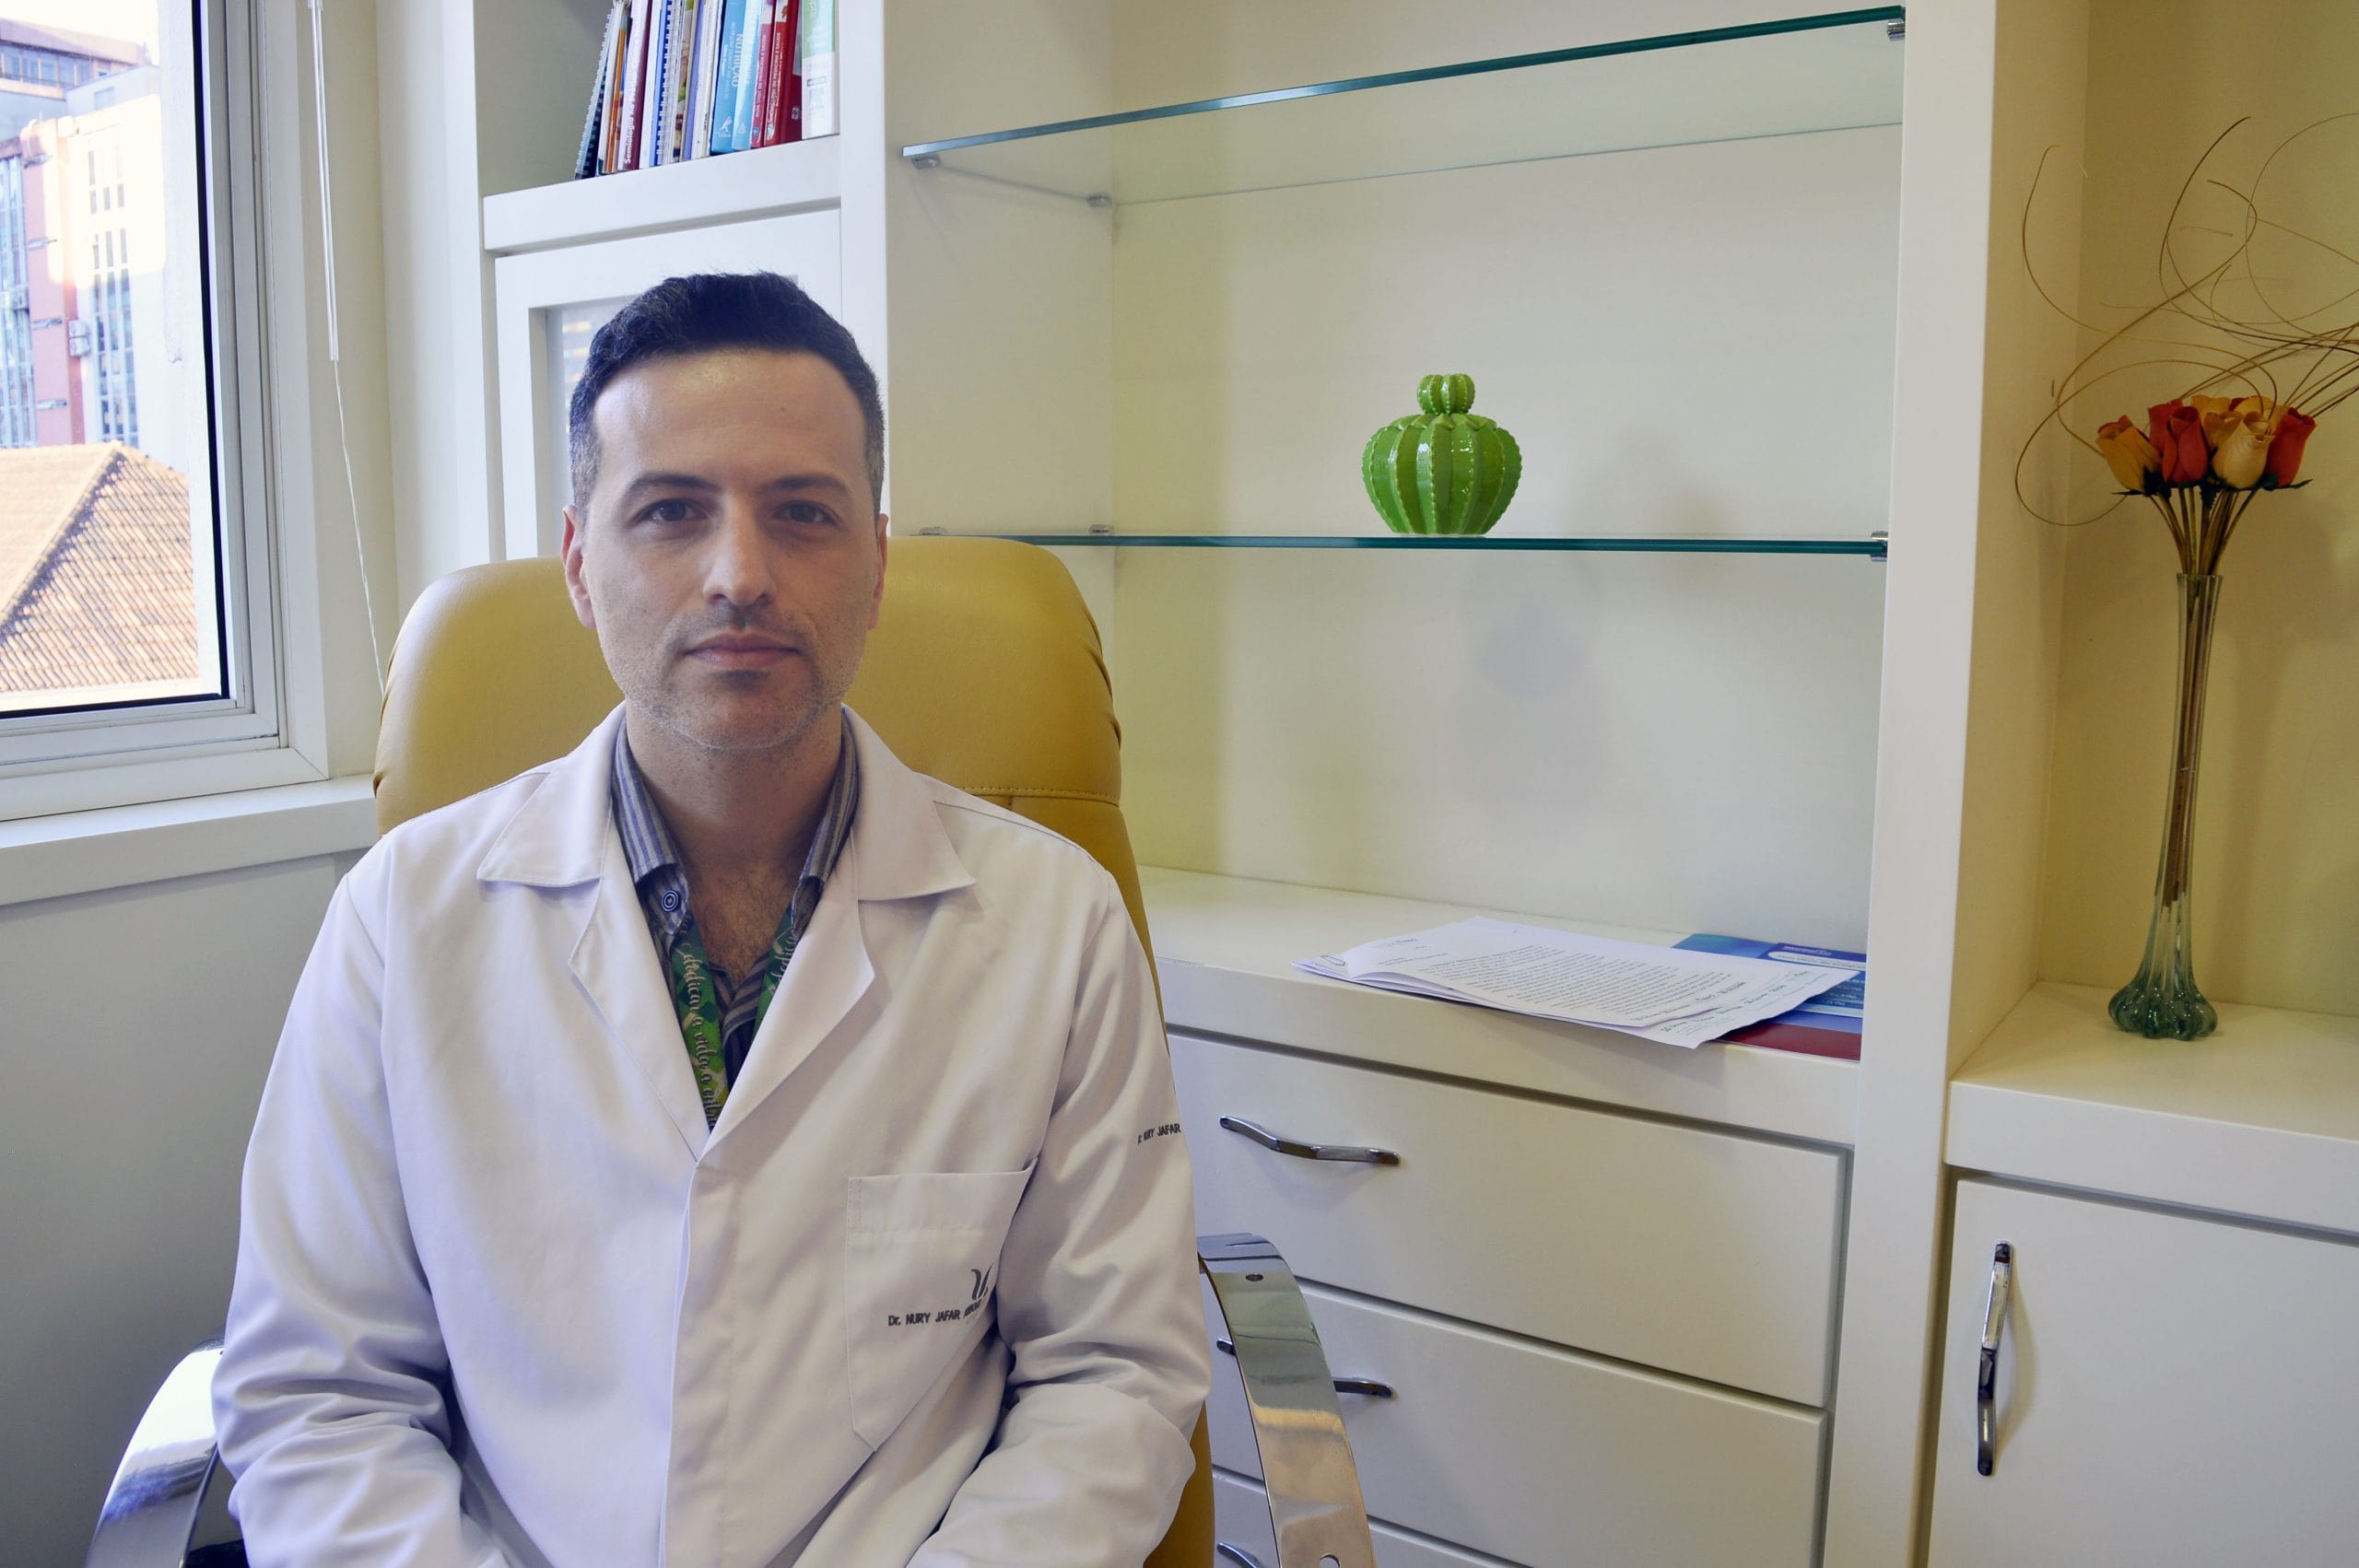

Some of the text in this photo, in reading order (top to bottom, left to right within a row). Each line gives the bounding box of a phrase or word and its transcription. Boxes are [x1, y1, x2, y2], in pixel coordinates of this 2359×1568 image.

[625, 116, 635, 164] Semiologia
[684, 954, 706, 1012] dedicar
[693, 1015, 704, 1027] a
[694, 1031, 716, 1069] vida
[1157, 1123, 1181, 1137] JAFAR
[887, 1309, 960, 1327] Dr. NURY JAFAR
